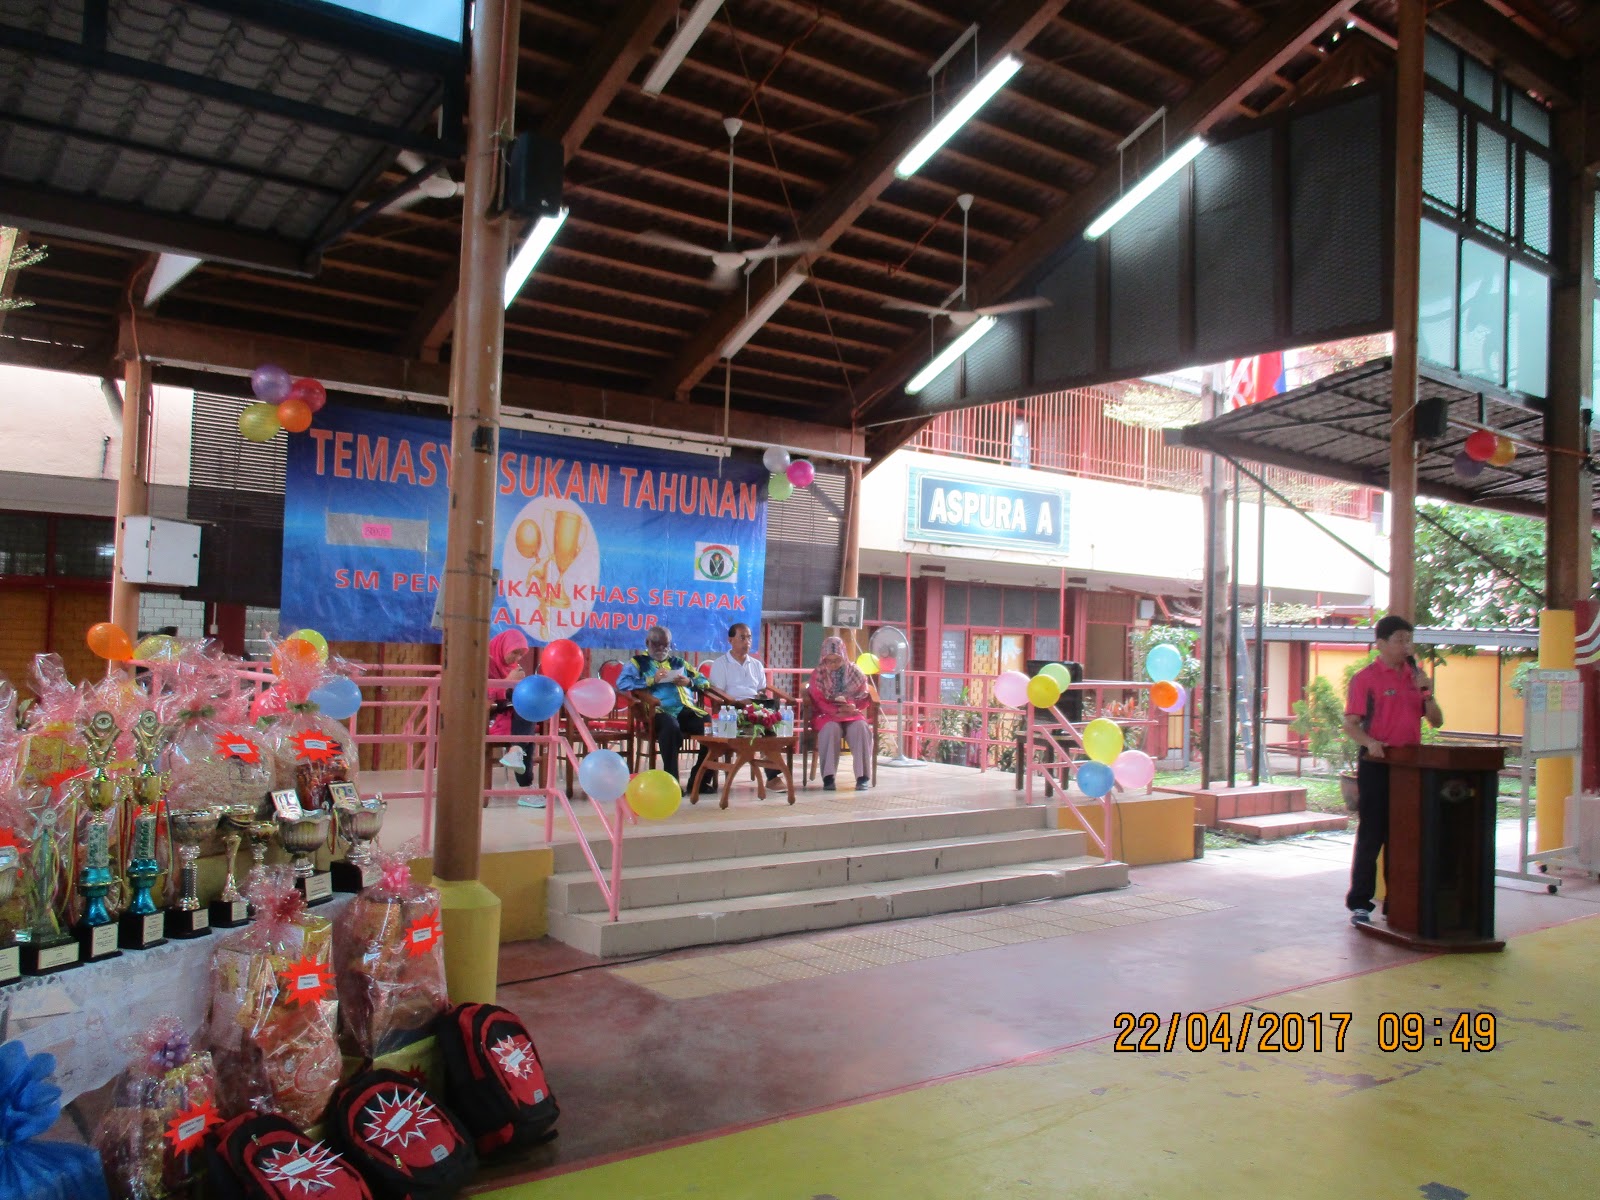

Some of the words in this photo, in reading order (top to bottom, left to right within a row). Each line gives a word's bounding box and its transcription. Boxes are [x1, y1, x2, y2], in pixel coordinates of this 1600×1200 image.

[310, 428, 454, 488] TEMASY
[500, 452, 610, 505] SUKAN
[620, 467, 757, 521] TAHUNAN
[928, 487, 1027, 533] ASPURA
[1035, 502, 1053, 535] A
[335, 569, 380, 590] SM
[573, 584, 640, 605] KHAS
[649, 589, 746, 611] SETAPAK
[556, 610, 659, 632] LUMPUR
